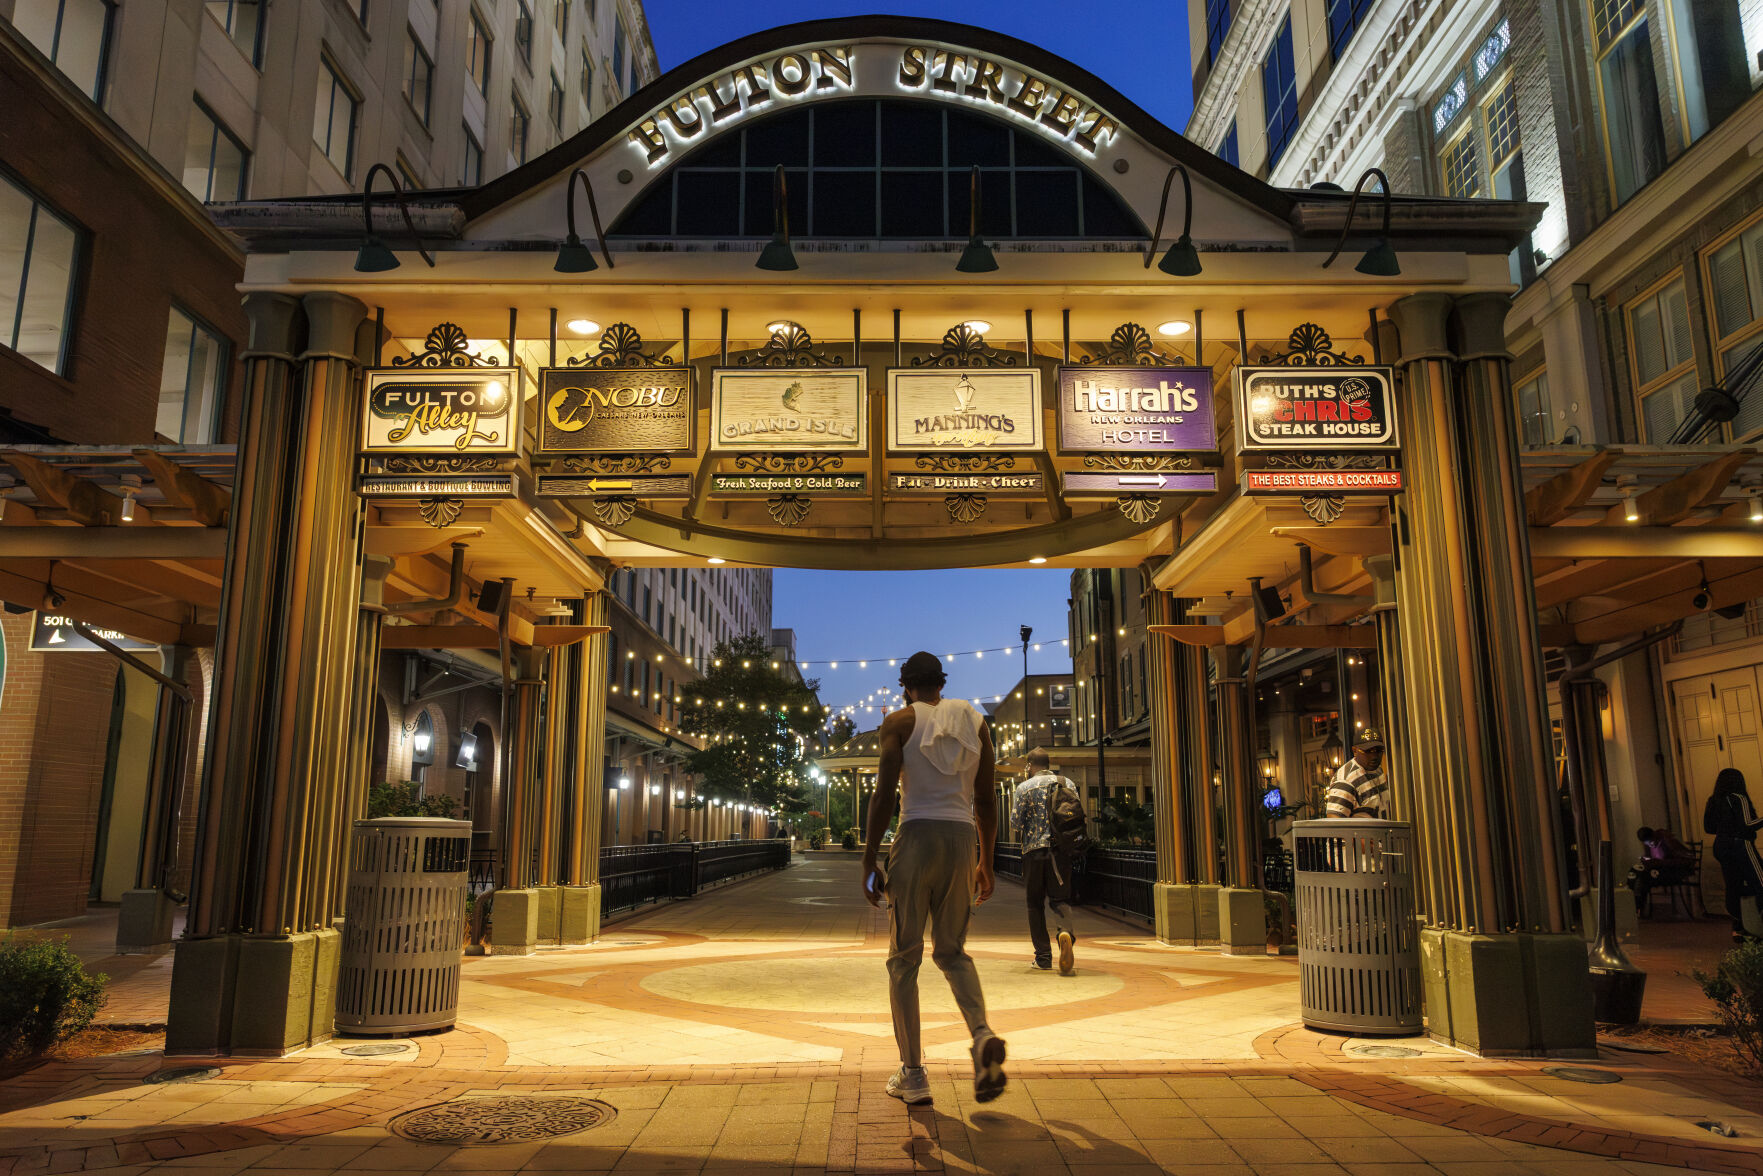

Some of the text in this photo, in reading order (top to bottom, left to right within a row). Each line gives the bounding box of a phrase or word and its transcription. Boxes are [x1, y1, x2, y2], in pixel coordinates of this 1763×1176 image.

[627, 46, 1119, 165] FULTON STREET
[581, 387, 684, 407] NOBU
[1261, 385, 1337, 398] RUTH'S
[1345, 391, 1368, 402] PRIME
[385, 391, 500, 406] FULTON
[1275, 400, 1373, 421] CHRIS
[388, 403, 499, 450] Alley
[914, 414, 1015, 434] MANNING'S
[1091, 416, 1184, 424] NEW ORLEANS
[723, 417, 855, 439] GRAND ISLE
[1260, 423, 1381, 435] STEAK HOUSE
[1102, 430, 1174, 443] HOTEL
[716, 477, 860, 491] Fresh Seafood & Cold Beer
[896, 476, 1036, 488] Eat Drink Cheer
[1252, 475, 1398, 485] THE BEST STEAKS & COCKTAILS
[43, 616, 63, 626] 501
